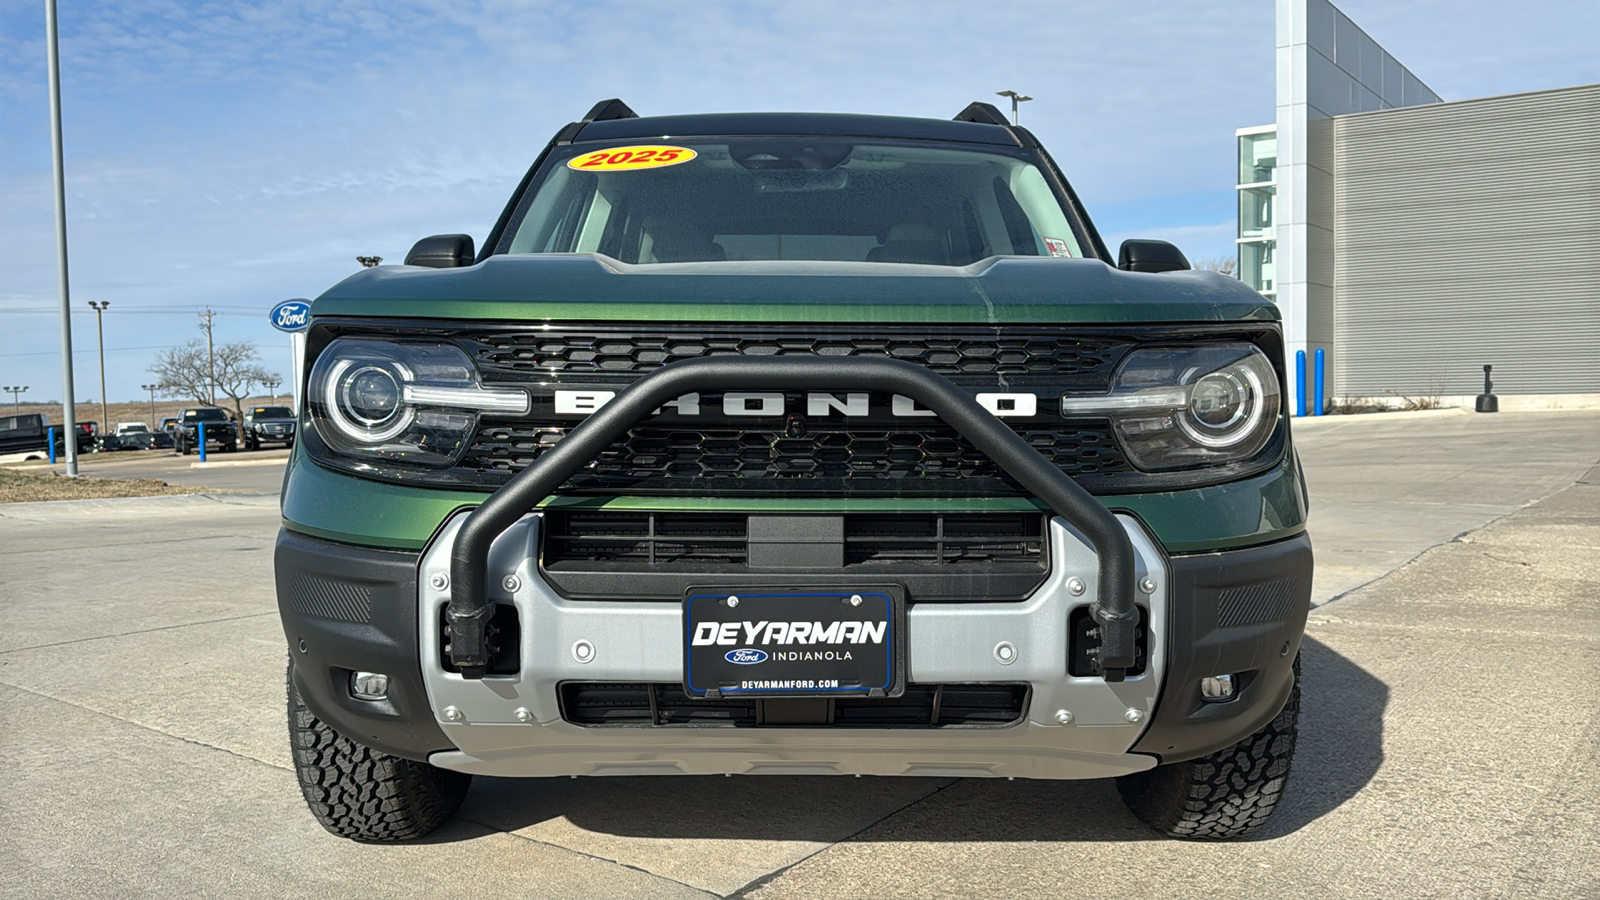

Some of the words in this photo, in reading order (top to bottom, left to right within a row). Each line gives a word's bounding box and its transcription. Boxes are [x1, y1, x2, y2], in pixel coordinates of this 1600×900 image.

[580, 150, 684, 168] 2025
[277, 305, 307, 326] Ford
[691, 621, 888, 646] DEYARMAN
[732, 650, 760, 662] Ford
[772, 651, 853, 661] INDIANOLA
[741, 679, 839, 690] DEYARMANFORD.COM
